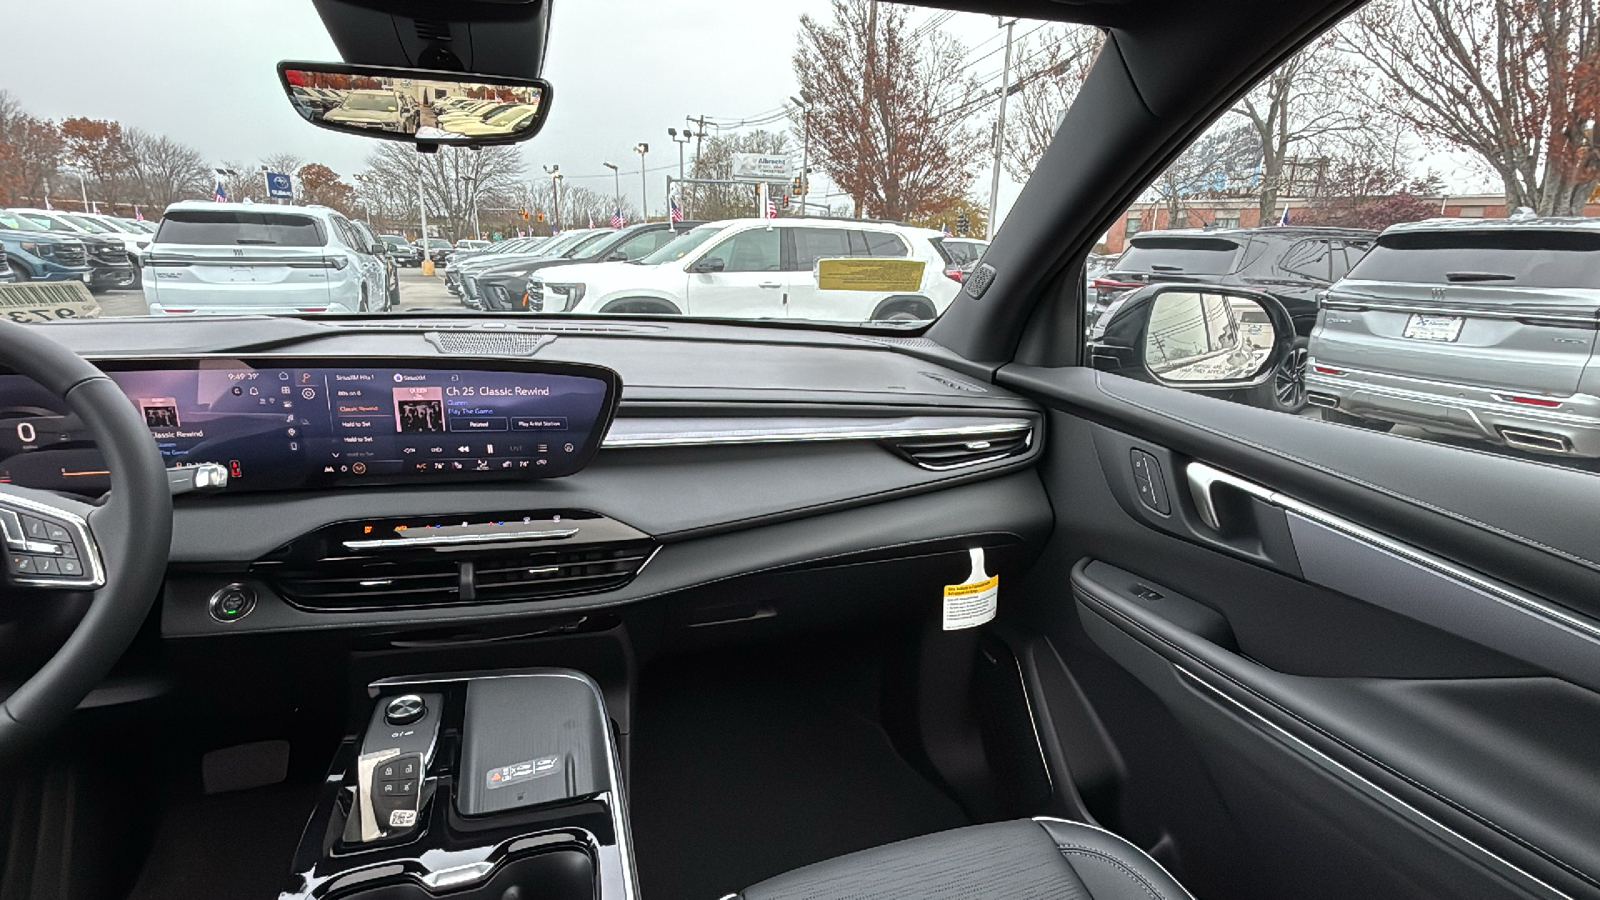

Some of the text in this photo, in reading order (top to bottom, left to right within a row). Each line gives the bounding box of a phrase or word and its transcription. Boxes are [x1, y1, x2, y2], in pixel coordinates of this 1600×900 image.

[446, 387, 550, 396] Ch 25 Classic Rewind
[17, 422, 36, 442] 0
[176, 430, 204, 438] Rewind
